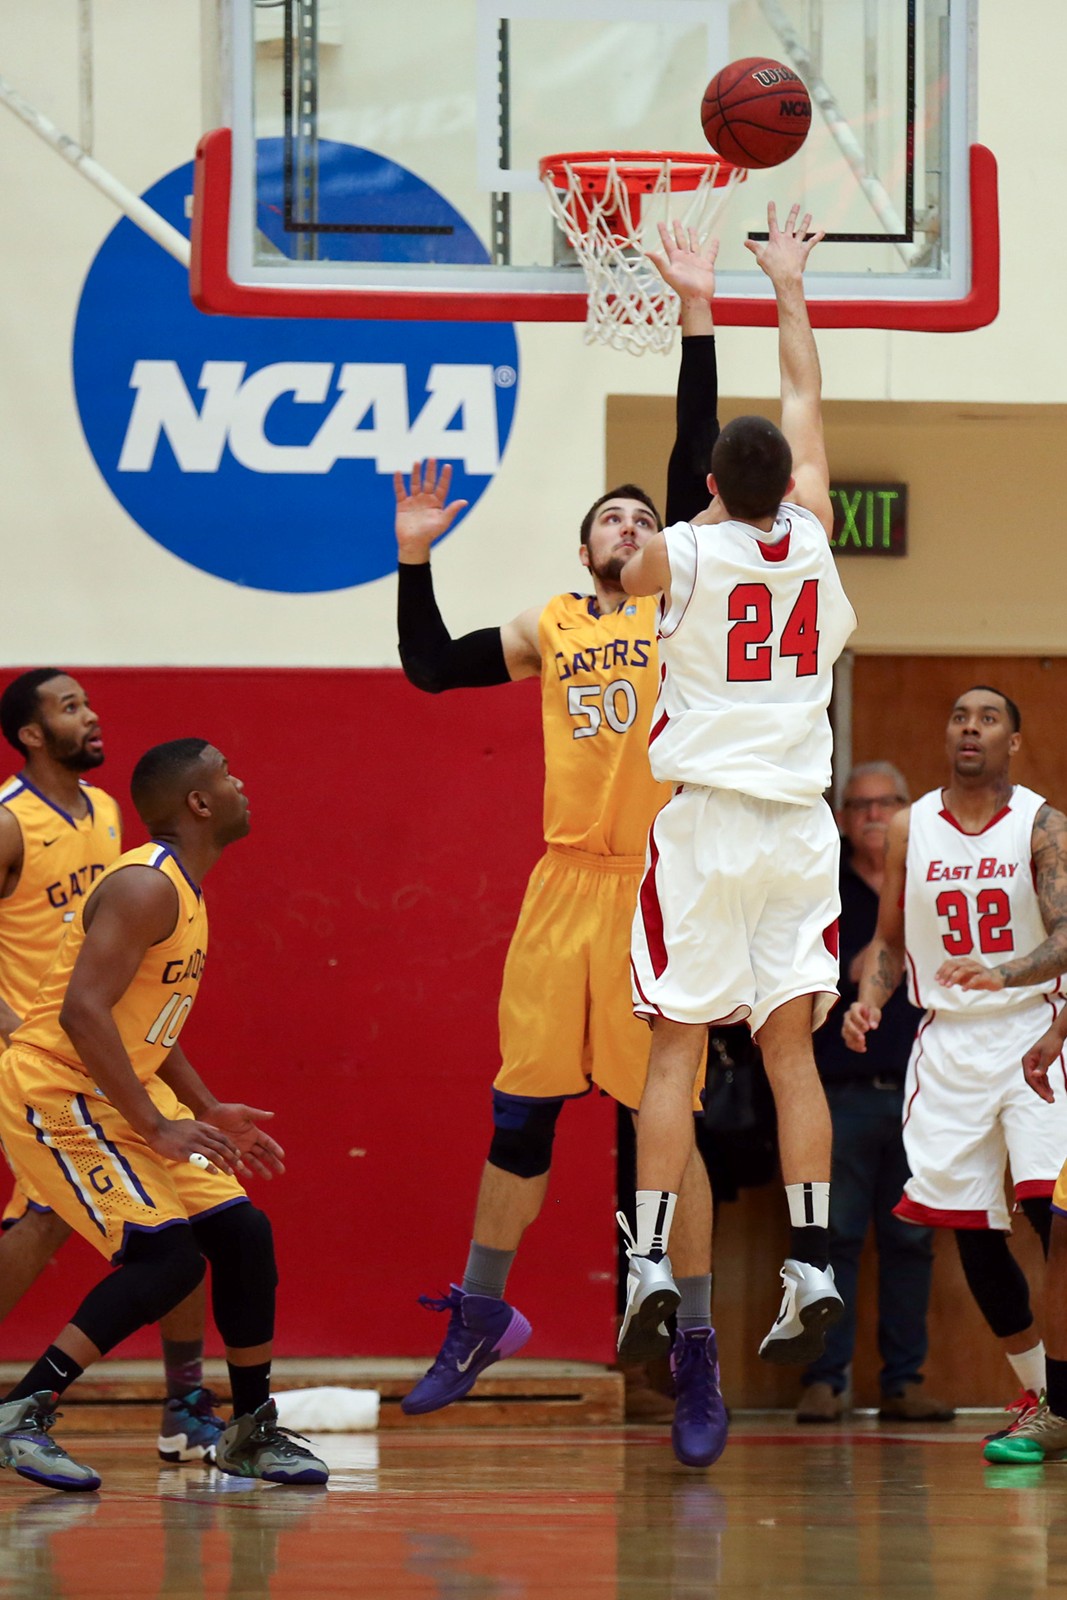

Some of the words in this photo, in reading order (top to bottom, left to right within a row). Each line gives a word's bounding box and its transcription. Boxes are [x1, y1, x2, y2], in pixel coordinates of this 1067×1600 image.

[829, 489, 899, 548] XIT
[727, 578, 820, 682] 24
[555, 638, 651, 680] GATORS
[567, 678, 638, 740] 50
[926, 860, 973, 882] EAST
[976, 857, 1019, 880] BAY
[935, 888, 1014, 956] 32
[144, 992, 193, 1048] 10
[87, 1164, 114, 1195] G
